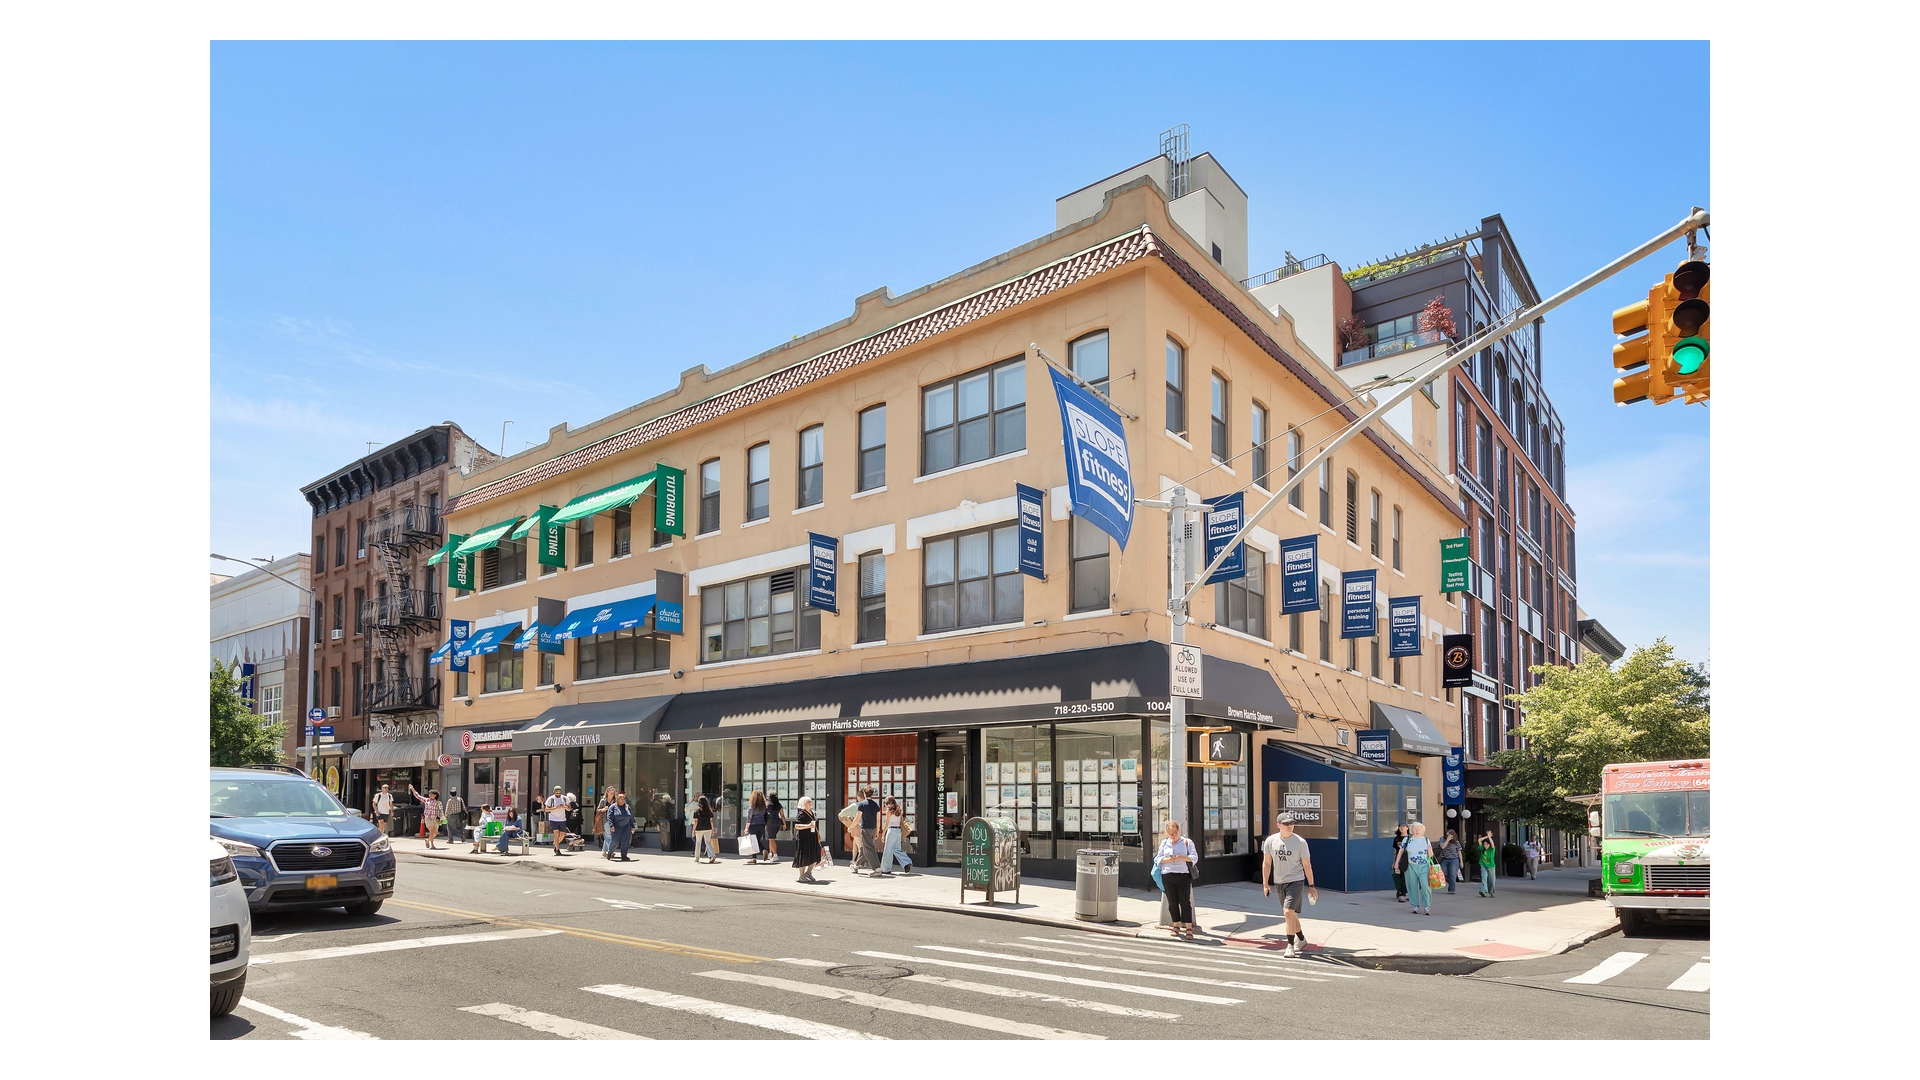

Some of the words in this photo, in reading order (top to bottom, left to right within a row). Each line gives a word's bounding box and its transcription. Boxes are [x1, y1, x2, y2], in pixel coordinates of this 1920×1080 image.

[1076, 418, 1125, 467] SLOPE
[1081, 448, 1129, 501] fitness
[666, 475, 676, 527] TUTORING
[1023, 504, 1039, 516] SLOPE
[1023, 515, 1040, 528] fitness
[1210, 512, 1236, 524] SLOPE
[1210, 523, 1238, 535] fitness
[548, 526, 558, 556] STING
[1027, 538, 1037, 546] child
[815, 549, 833, 560] SLOPE
[1287, 552, 1310, 562] SLOPE
[815, 559, 834, 569] fitness
[1287, 561, 1312, 571] fitness
[457, 562, 467, 585] PREP
[817, 573, 831, 581] strength
[812, 586, 835, 597] conditioning
[1347, 593, 1370, 601] fitness
[659, 608, 680, 618] charles
[1347, 607, 1371, 615] personal
[659, 615, 681, 624] SCHWAB
[1452, 652, 1463, 663] B
[1175, 665, 1197, 674] ALLOWED
[1177, 675, 1187, 683] USE
[1173, 685, 1186, 693] FULL
[1054, 701, 1115, 715] 718-230-5500
[1146, 701, 1171, 711] 100A
[1227, 706, 1243, 718] Brown
[1243, 708, 1257, 720] Harris
[1257, 711, 1274, 723] Stevens
[382, 721, 404, 742] Bagel
[406, 719, 438, 736] Market
[810, 721, 831, 731] Brown
[832, 720, 852, 729] Harris
[853, 719, 880, 728] Stevens
[544, 731, 571, 747] charles
[571, 733, 600, 746] SCHWAB
[1362, 751, 1385, 759] fitness
[1617, 770, 1671, 779] Authentic
[1614, 780, 1640, 789] Free
[1642, 777, 1690, 789] Delivery
[1287, 797, 1319, 807] SLOPE
[969, 826, 988, 842] YOU
[966, 841, 987, 856] FEEL
[966, 857, 985, 866] LIKE
[966, 867, 989, 882] HOME
